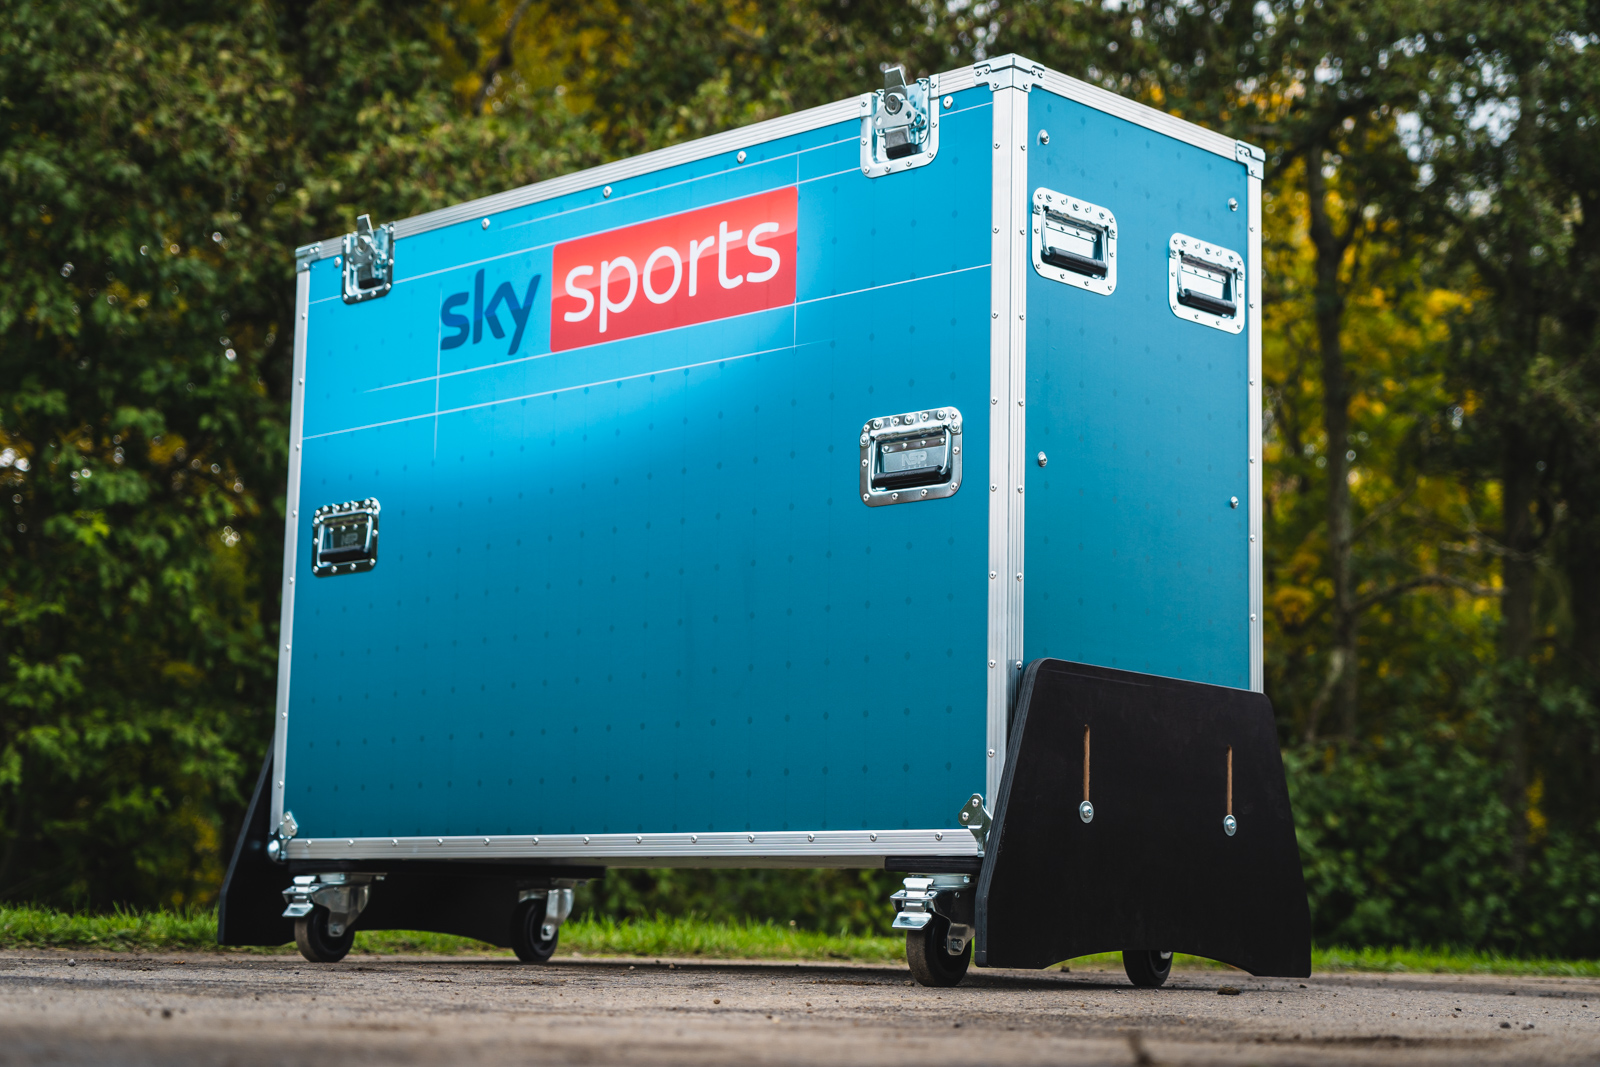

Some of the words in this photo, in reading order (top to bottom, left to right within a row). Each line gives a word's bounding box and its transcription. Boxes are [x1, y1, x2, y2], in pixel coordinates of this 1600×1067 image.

[440, 268, 541, 355] sky
[564, 221, 781, 333] sports
[902, 451, 927, 467] NSP
